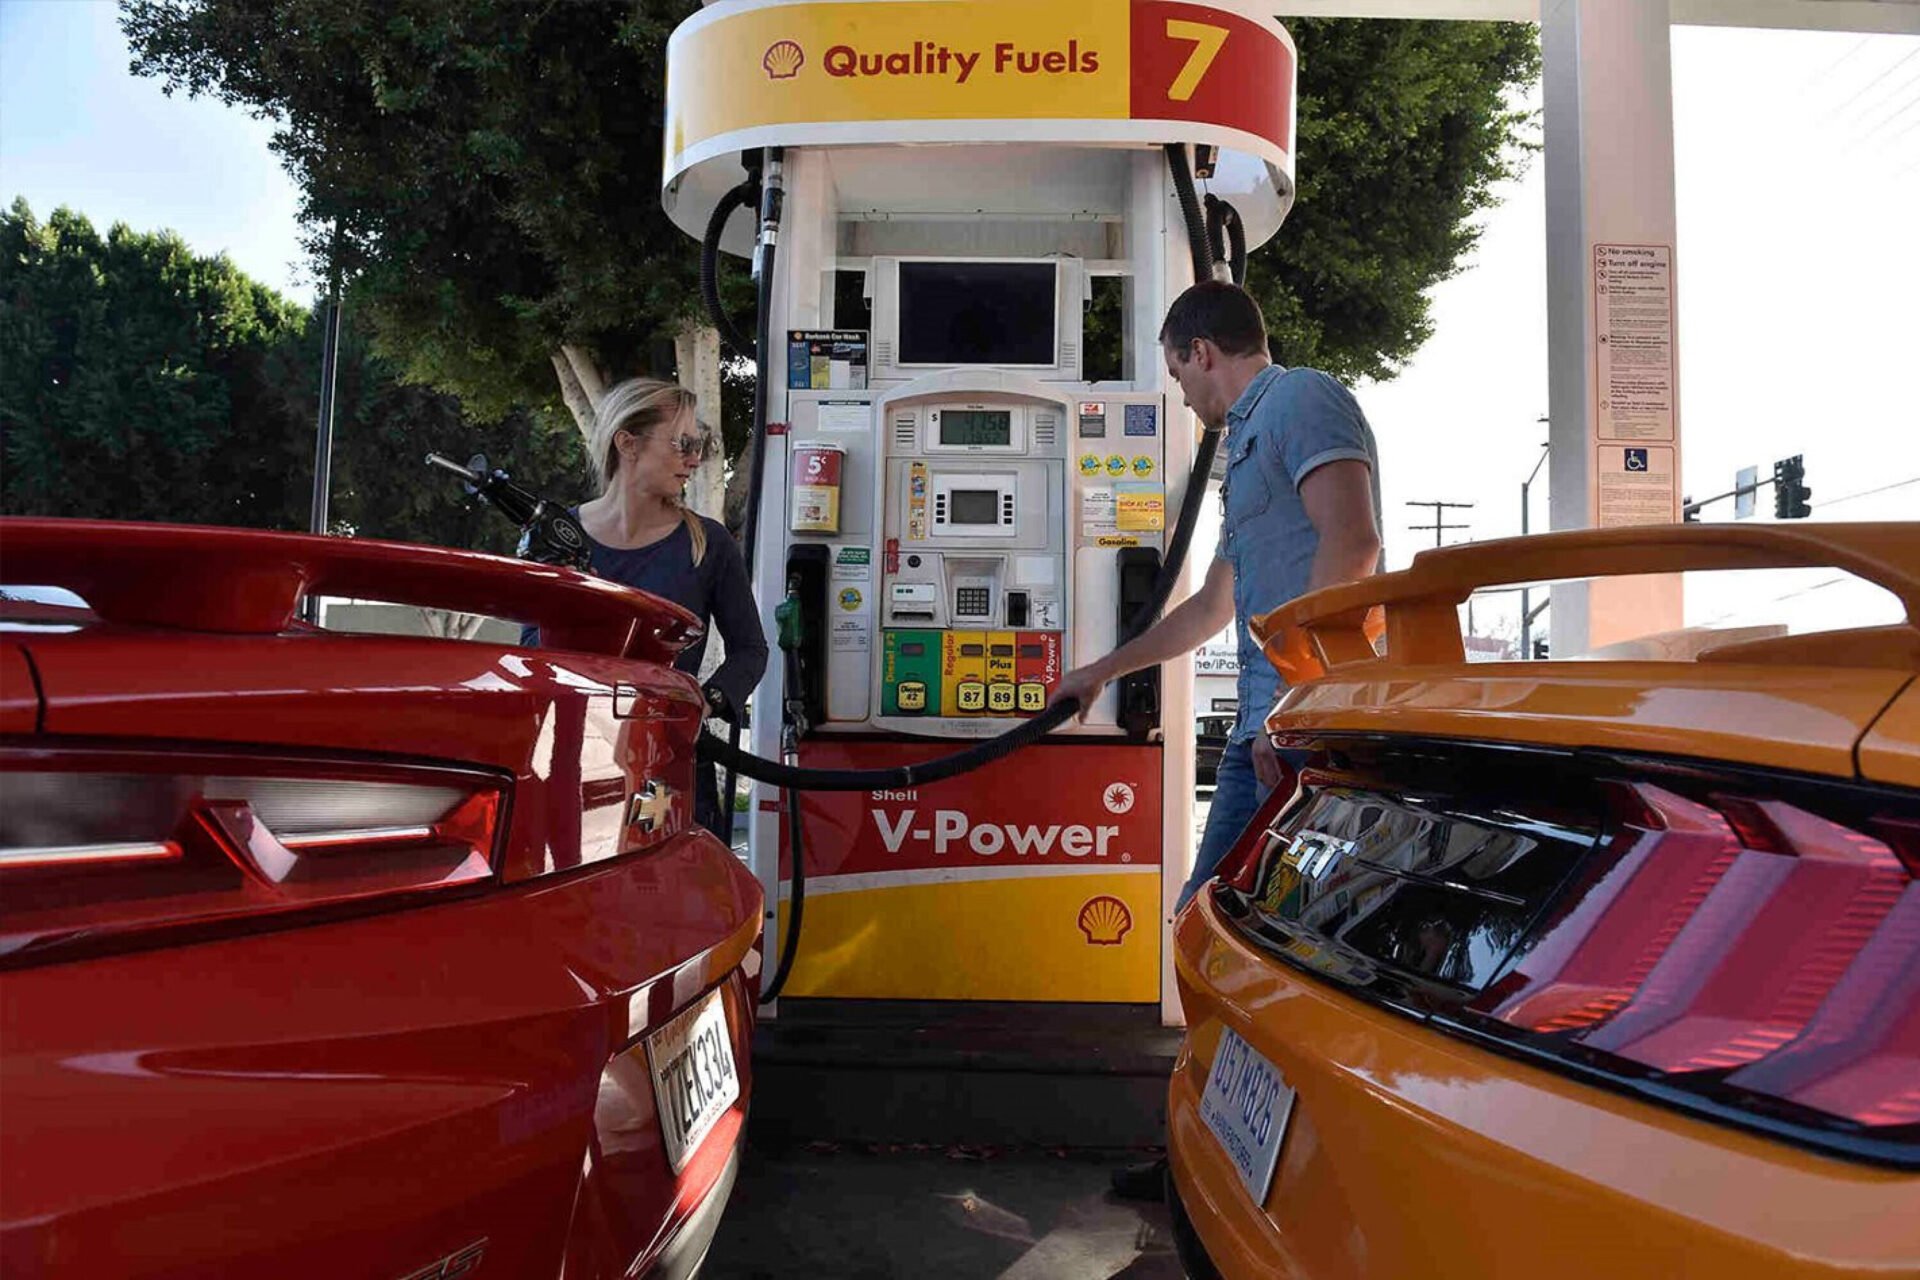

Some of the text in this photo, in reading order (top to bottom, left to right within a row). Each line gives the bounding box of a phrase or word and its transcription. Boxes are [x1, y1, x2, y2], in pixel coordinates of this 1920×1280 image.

[823, 40, 1099, 83] Quality Fuels
[1166, 18, 1231, 101] 7
[1608, 247, 1655, 257] No smoking
[1608, 259, 1625, 267] Turn
[1098, 538, 1138, 547] Gasoline
[944, 634, 956, 676] Regular
[1046, 637, 1056, 684] V-Power
[990, 659, 1012, 670] Plus
[900, 685, 925, 694] Diesel
[963, 691, 981, 703] 87
[993, 691, 1011, 703] 89
[1023, 692, 1041, 704] 91
[871, 789, 918, 801] Shell
[871, 808, 1119, 857] V-Power
